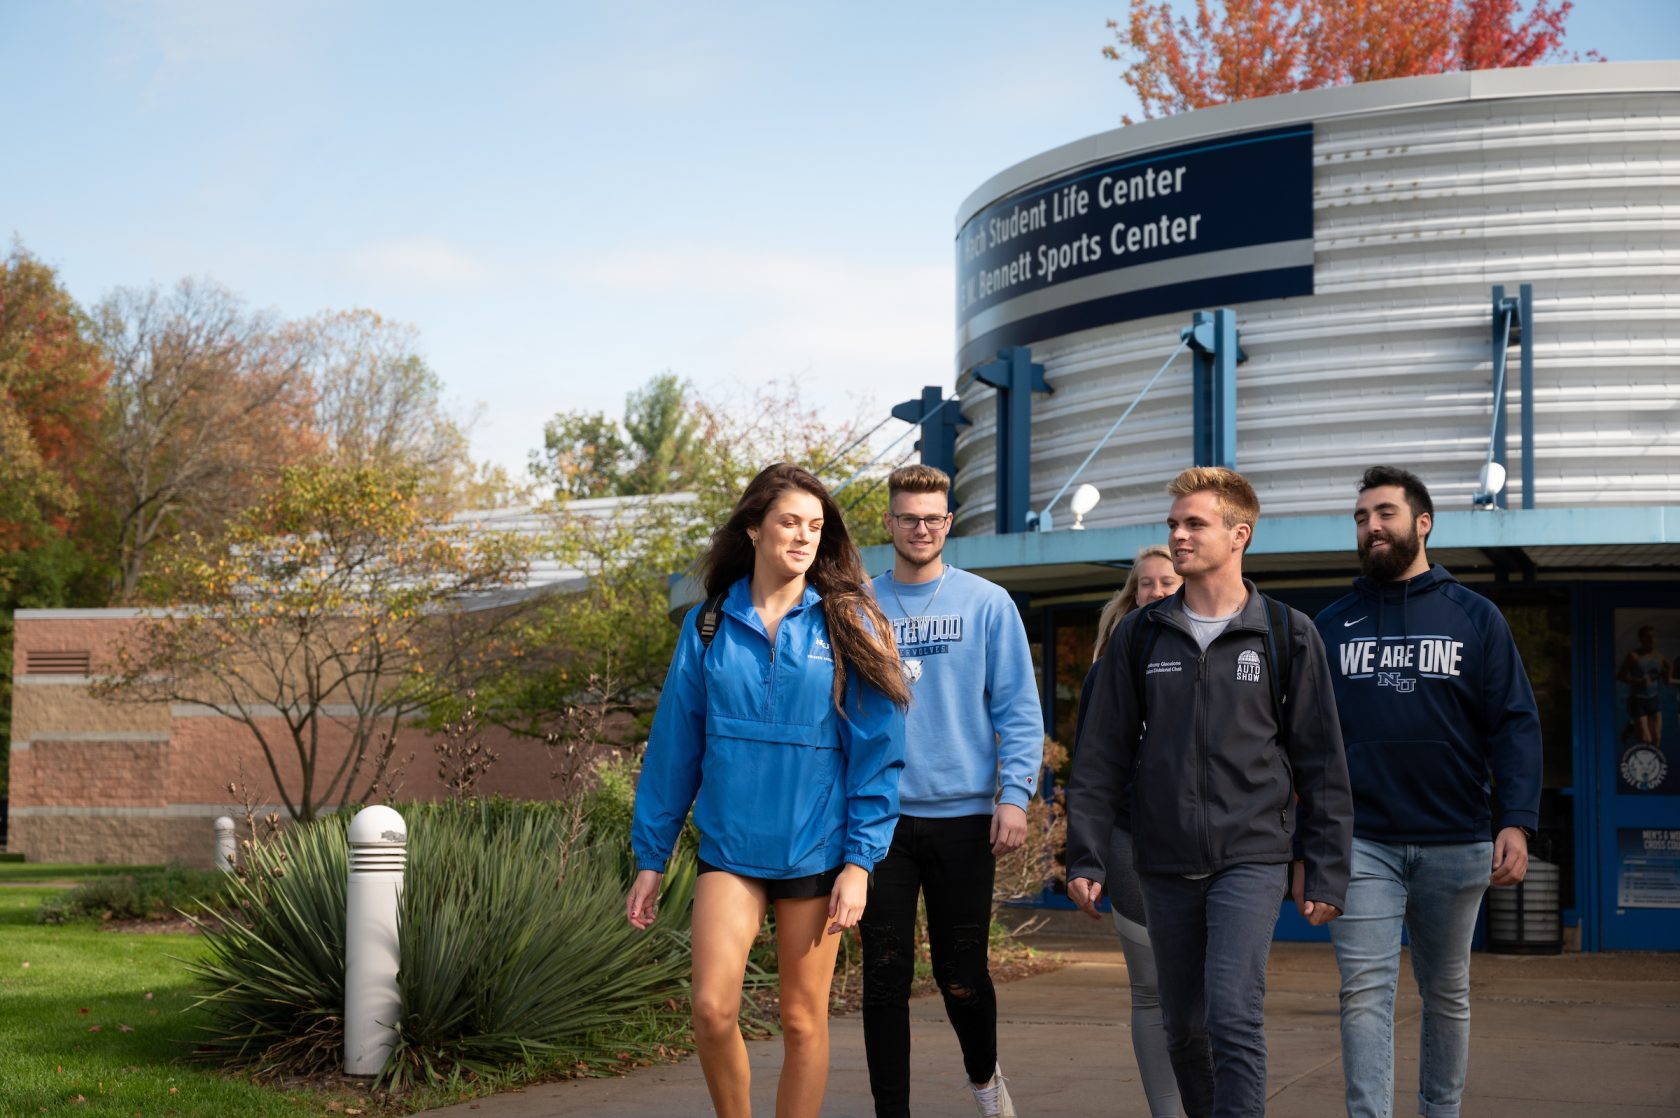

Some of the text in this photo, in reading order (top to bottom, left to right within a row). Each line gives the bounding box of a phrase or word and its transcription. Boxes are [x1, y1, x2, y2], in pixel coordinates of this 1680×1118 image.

[990, 199, 1047, 247] Student
[1053, 185, 1089, 223] Life
[1098, 166, 1186, 208] Center
[979, 251, 1032, 299] Bennett
[1037, 233, 1101, 282] Sports
[1111, 214, 1201, 255] Center
[892, 615, 963, 645] THWOOD
[1237, 664, 1260, 675] AUTO
[1340, 640, 1464, 677] WE ARE ONE
[1236, 673, 1260, 682] SHOW
[1378, 672, 1416, 693] NU
